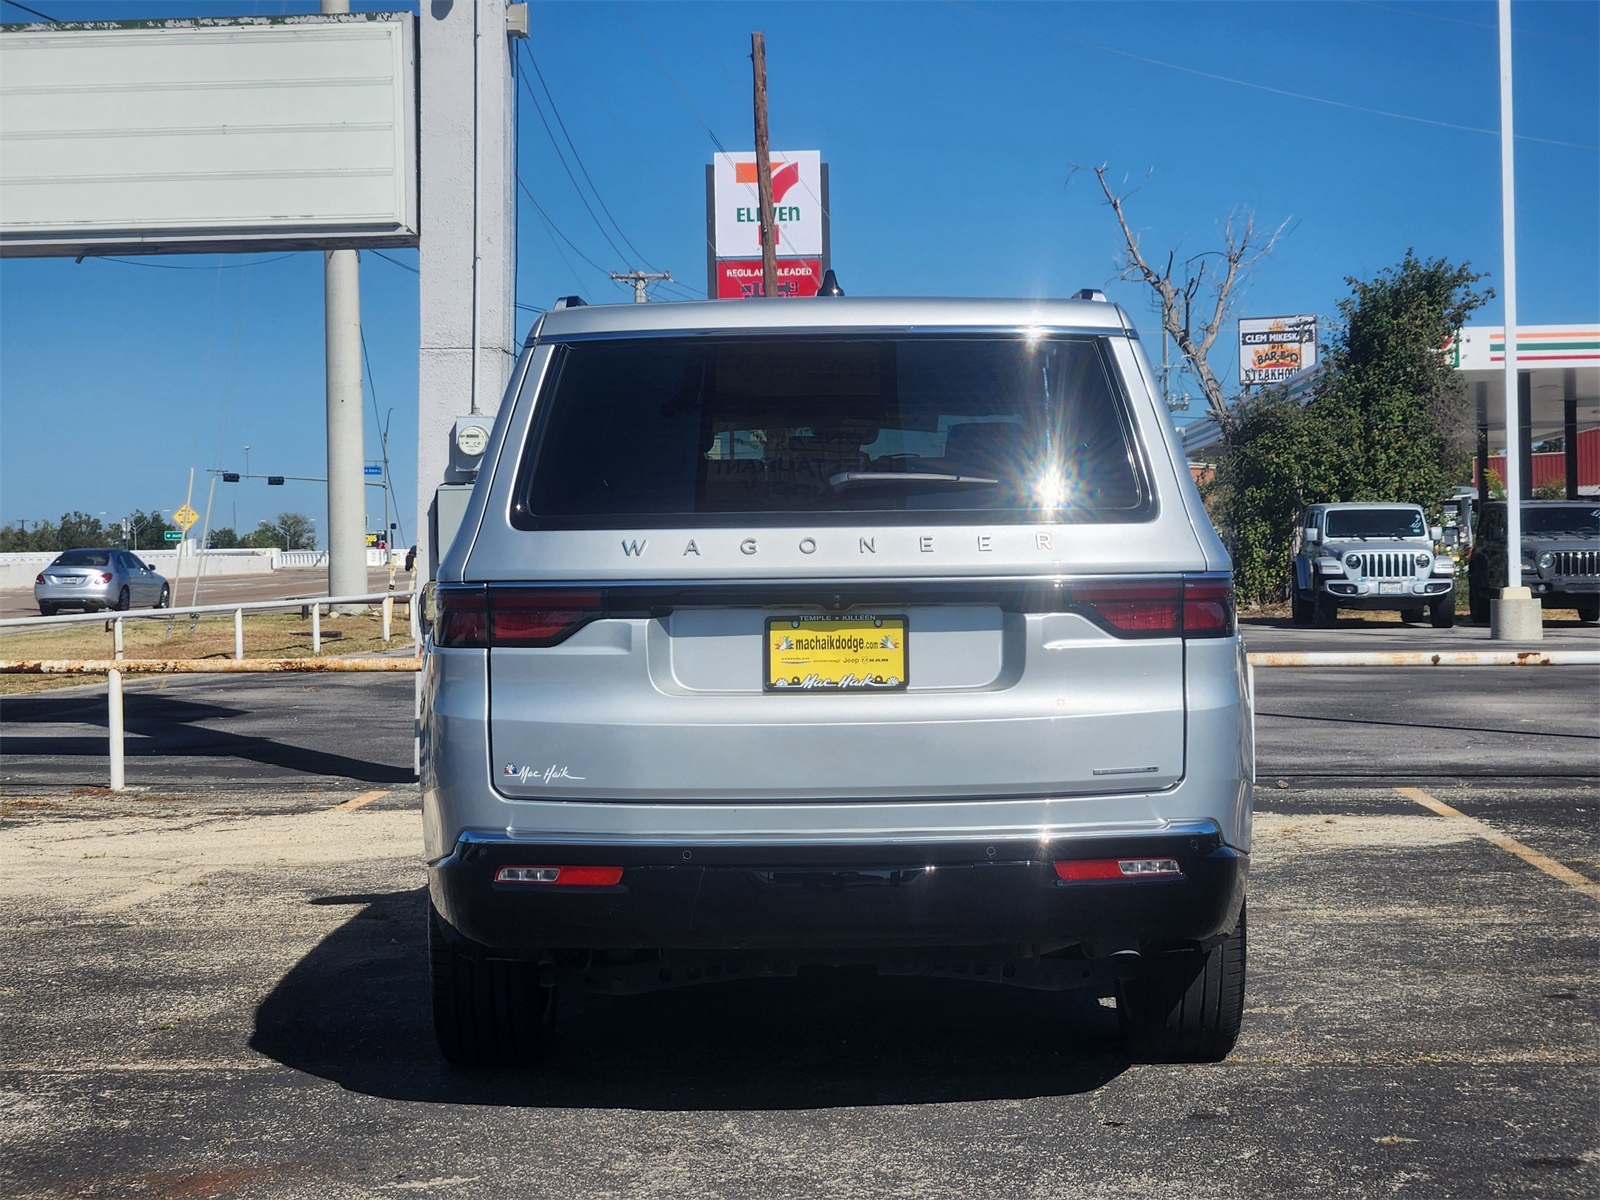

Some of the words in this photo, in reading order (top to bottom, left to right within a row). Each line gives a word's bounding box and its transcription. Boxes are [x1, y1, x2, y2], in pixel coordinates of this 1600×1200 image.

[776, 267, 812, 276] NLEADED
[1245, 334, 1267, 343] CLEM
[621, 532, 1054, 557] WAGONEER
[795, 634, 879, 652] machaikdodge.com
[801, 674, 838, 689] Mac
[838, 673, 880, 688] Haik
[518, 765, 542, 784] Mac
[543, 764, 577, 785] Haik
